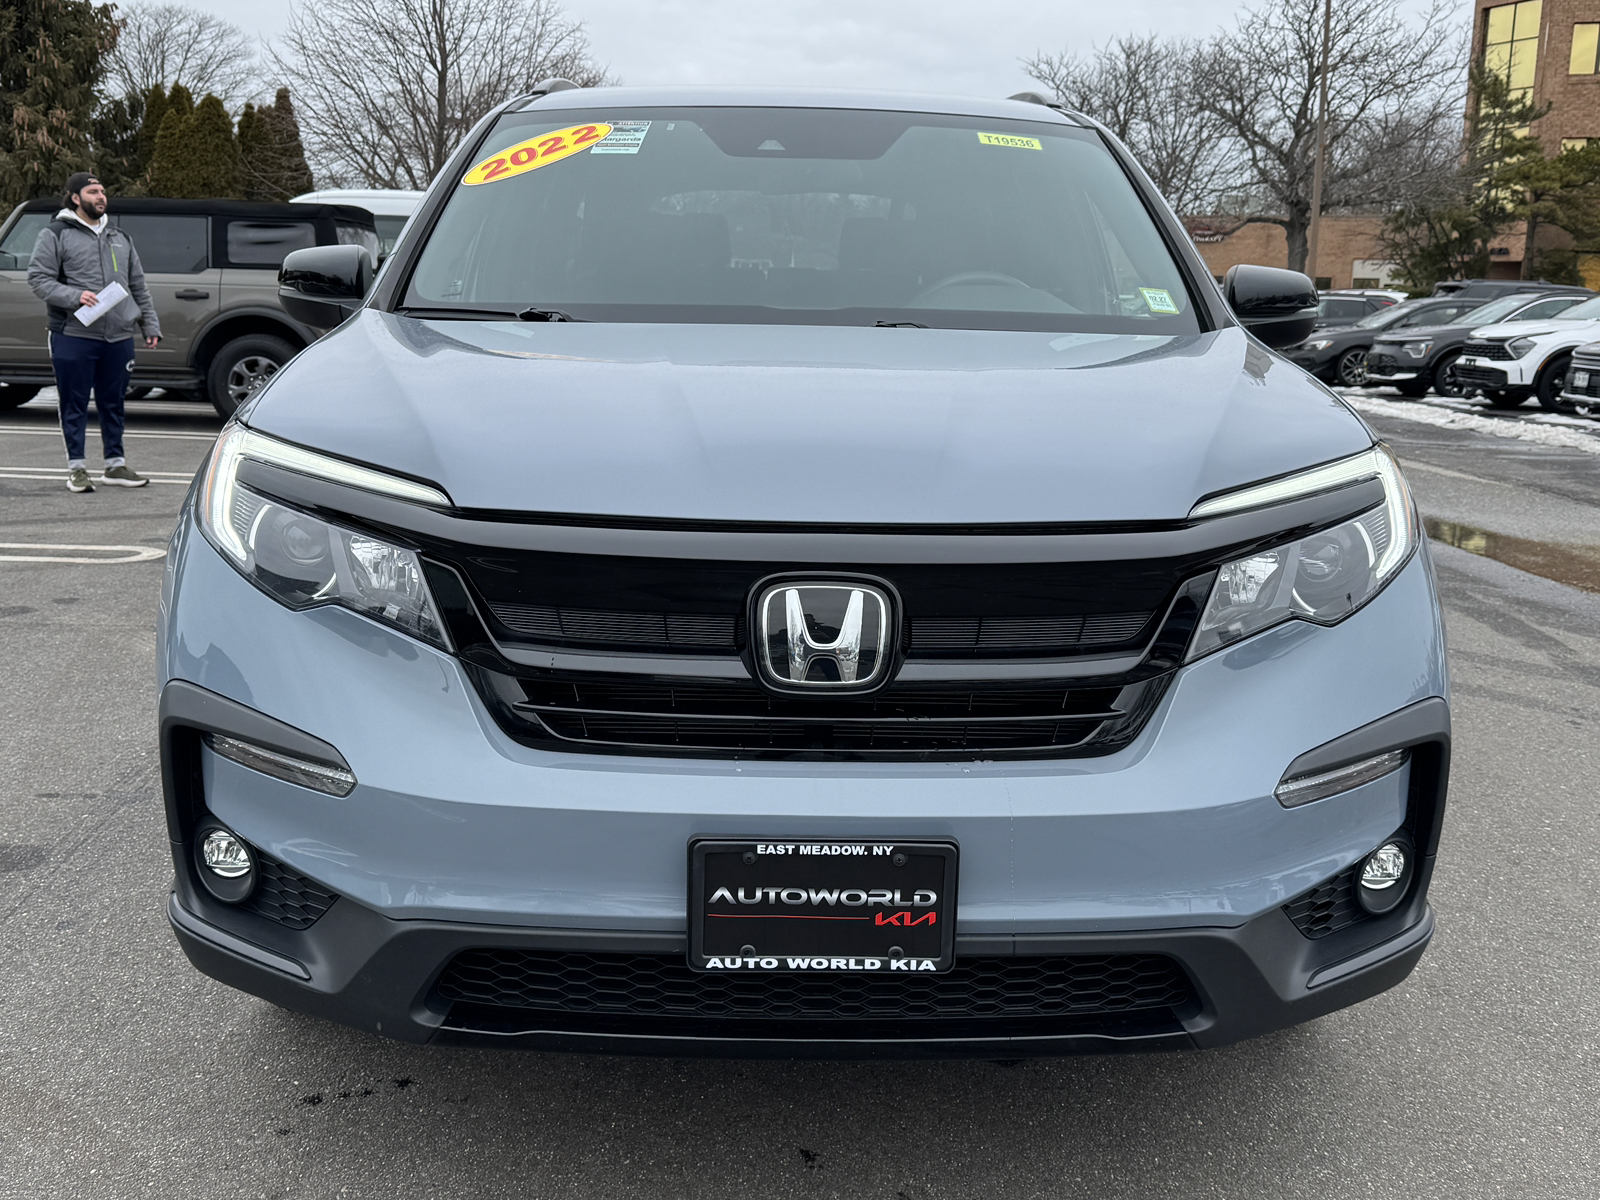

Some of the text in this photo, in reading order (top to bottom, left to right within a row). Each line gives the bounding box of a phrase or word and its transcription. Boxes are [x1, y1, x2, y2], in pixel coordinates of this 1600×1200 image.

[984, 135, 1034, 147] T19536
[481, 126, 601, 180] 2022
[756, 844, 796, 855] EAST
[872, 846, 894, 856] NY
[707, 886, 938, 907] AUTOWORLD
[875, 911, 937, 926] KIA
[705, 957, 937, 971] AUTO WORLD KIA
